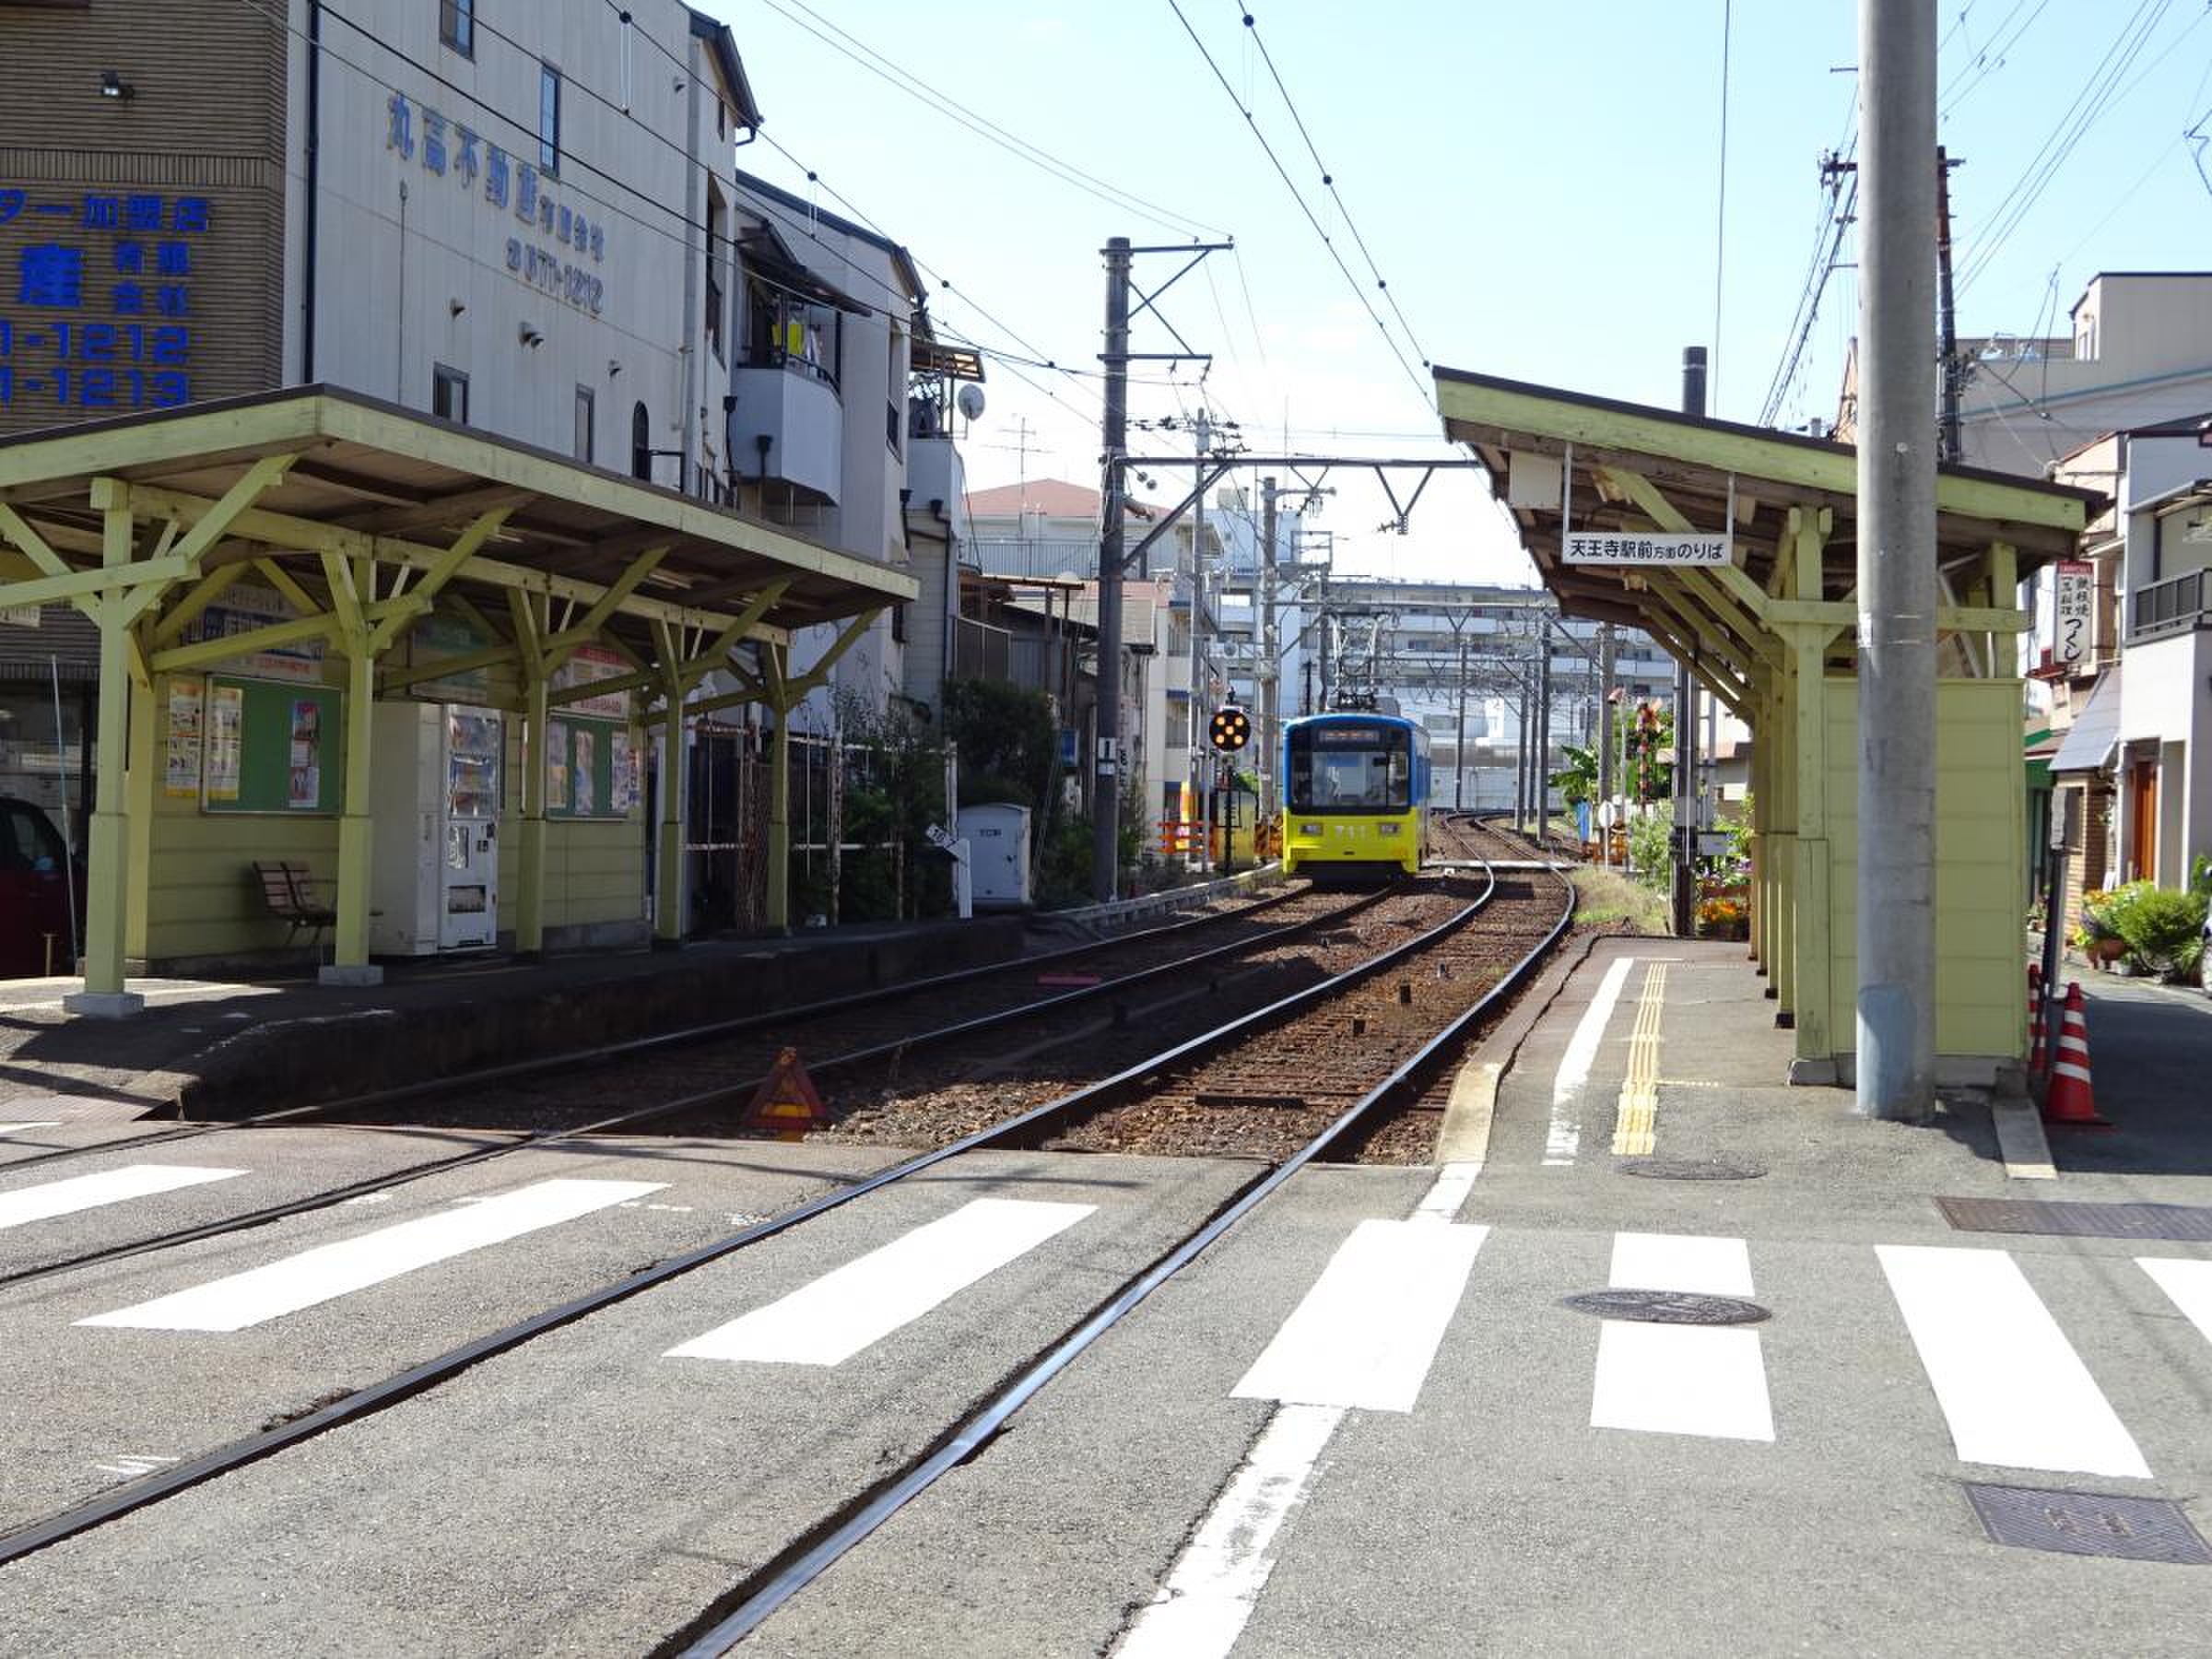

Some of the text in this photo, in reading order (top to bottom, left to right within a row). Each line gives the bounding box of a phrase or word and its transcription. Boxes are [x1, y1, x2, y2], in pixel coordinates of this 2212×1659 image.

[1570, 538, 1724, 560] 天王寺駅前方面のりば
[2065, 618, 2083, 661] つくし
